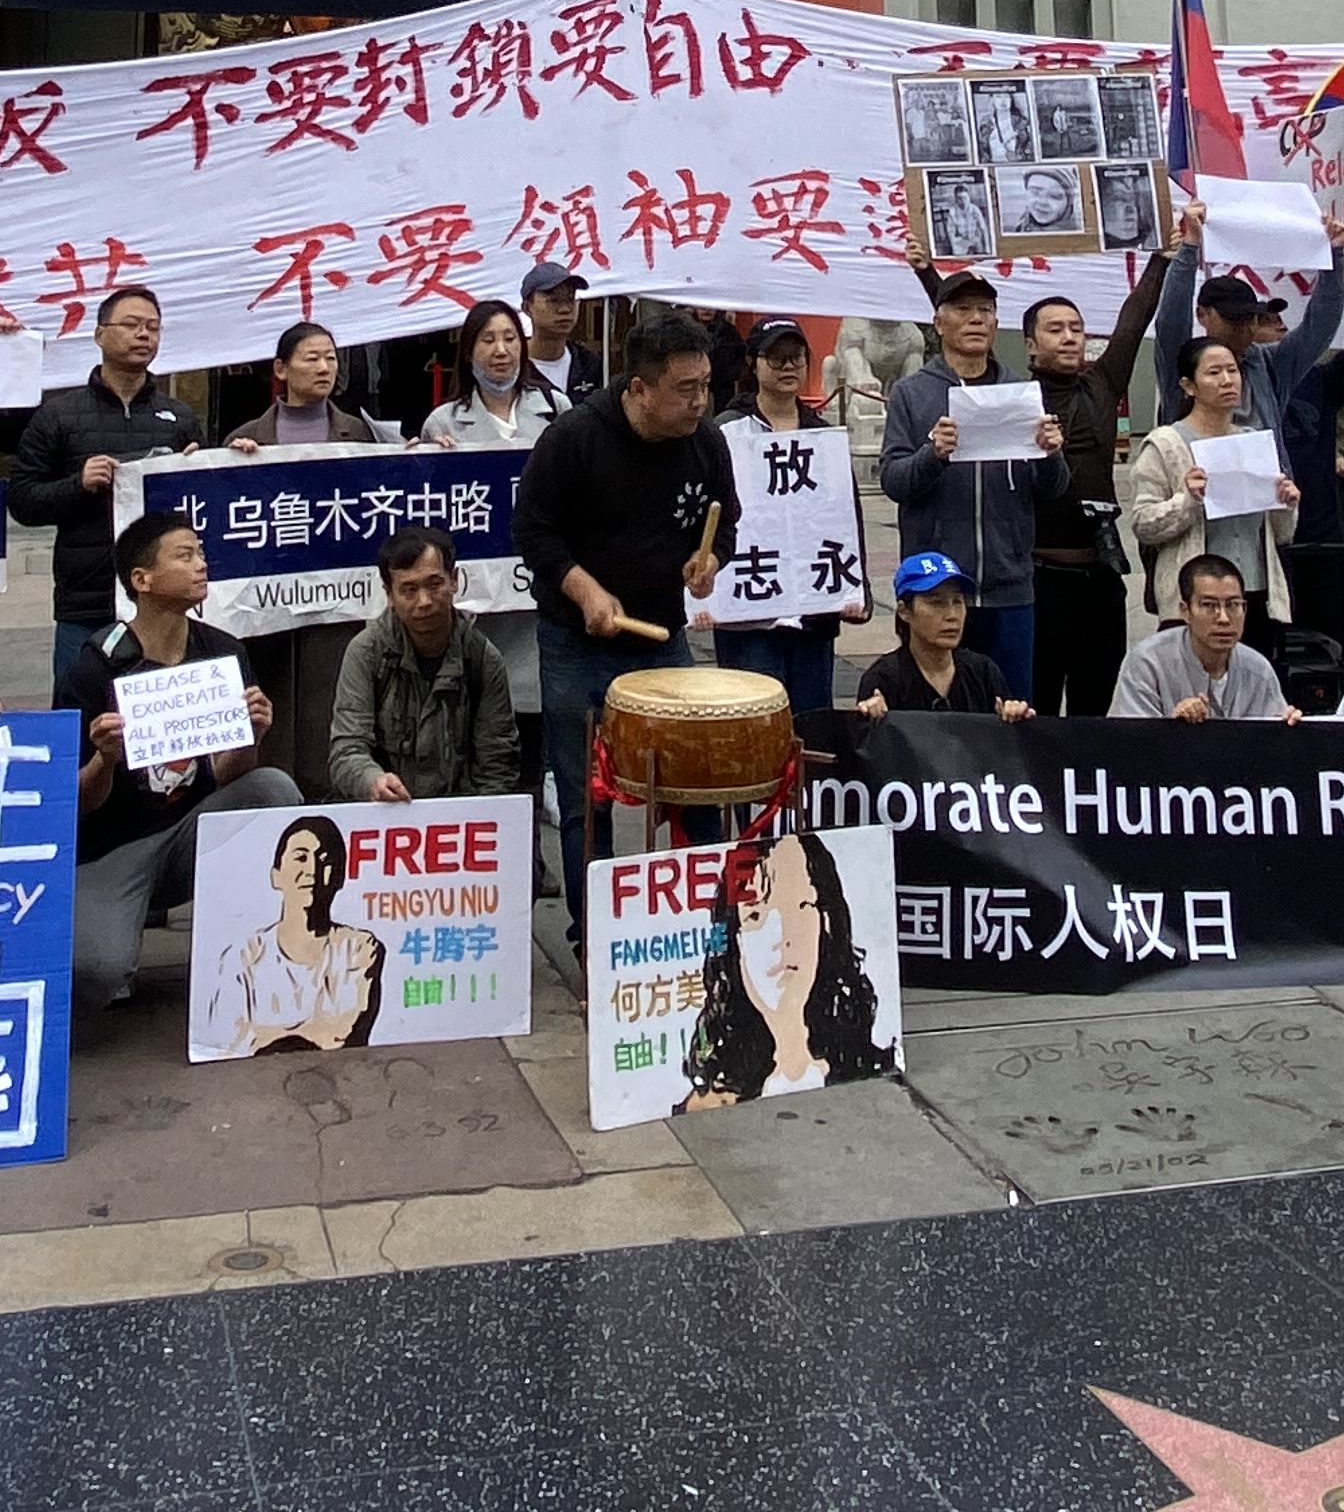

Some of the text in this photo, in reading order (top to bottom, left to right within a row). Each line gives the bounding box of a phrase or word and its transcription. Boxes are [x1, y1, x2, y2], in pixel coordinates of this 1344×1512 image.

[223, 479, 494, 550] 乌鲁木齐中路
[256, 571, 373, 609] Wulumuqi
[122, 664, 226, 697] RELEASE &
[131, 684, 231, 720] EXONERATE
[128, 706, 250, 743] ALL PROTESTORS
[774, 772, 1044, 834] morate
[1064, 767, 1299, 837] Human
[347, 819, 501, 882] FREE
[361, 882, 501, 924] TENGYU NIU
[611, 844, 759, 920] FREE
[896, 882, 1240, 964] 国际人权日
[610, 968, 707, 1024] 何方美
